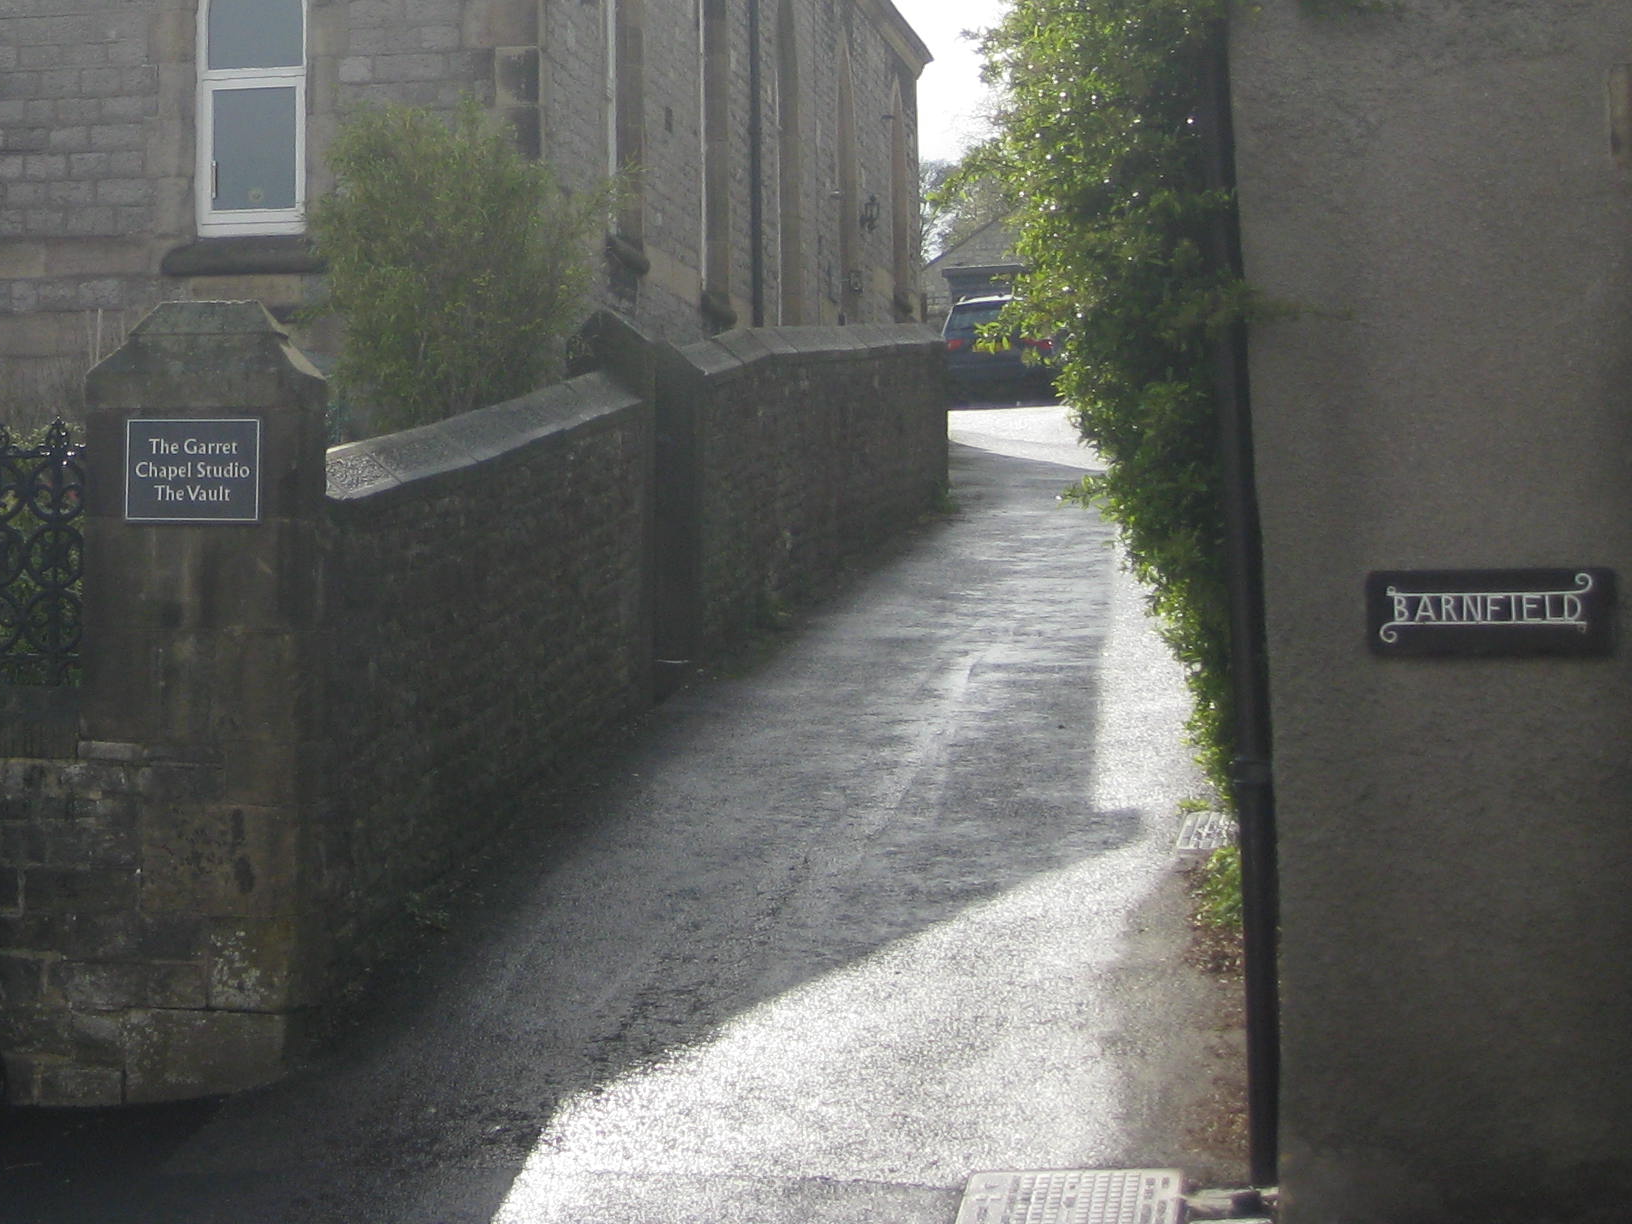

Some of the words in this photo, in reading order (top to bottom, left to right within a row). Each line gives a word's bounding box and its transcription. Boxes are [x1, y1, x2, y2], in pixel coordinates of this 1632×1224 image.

[148, 438, 179, 455] The
[183, 438, 238, 455] Garret
[135, 461, 192, 481] Chapel
[196, 461, 250, 478] Studio
[154, 485, 185, 501] The
[186, 485, 231, 502] Vault
[1393, 593, 1582, 624] BARNFIELD
